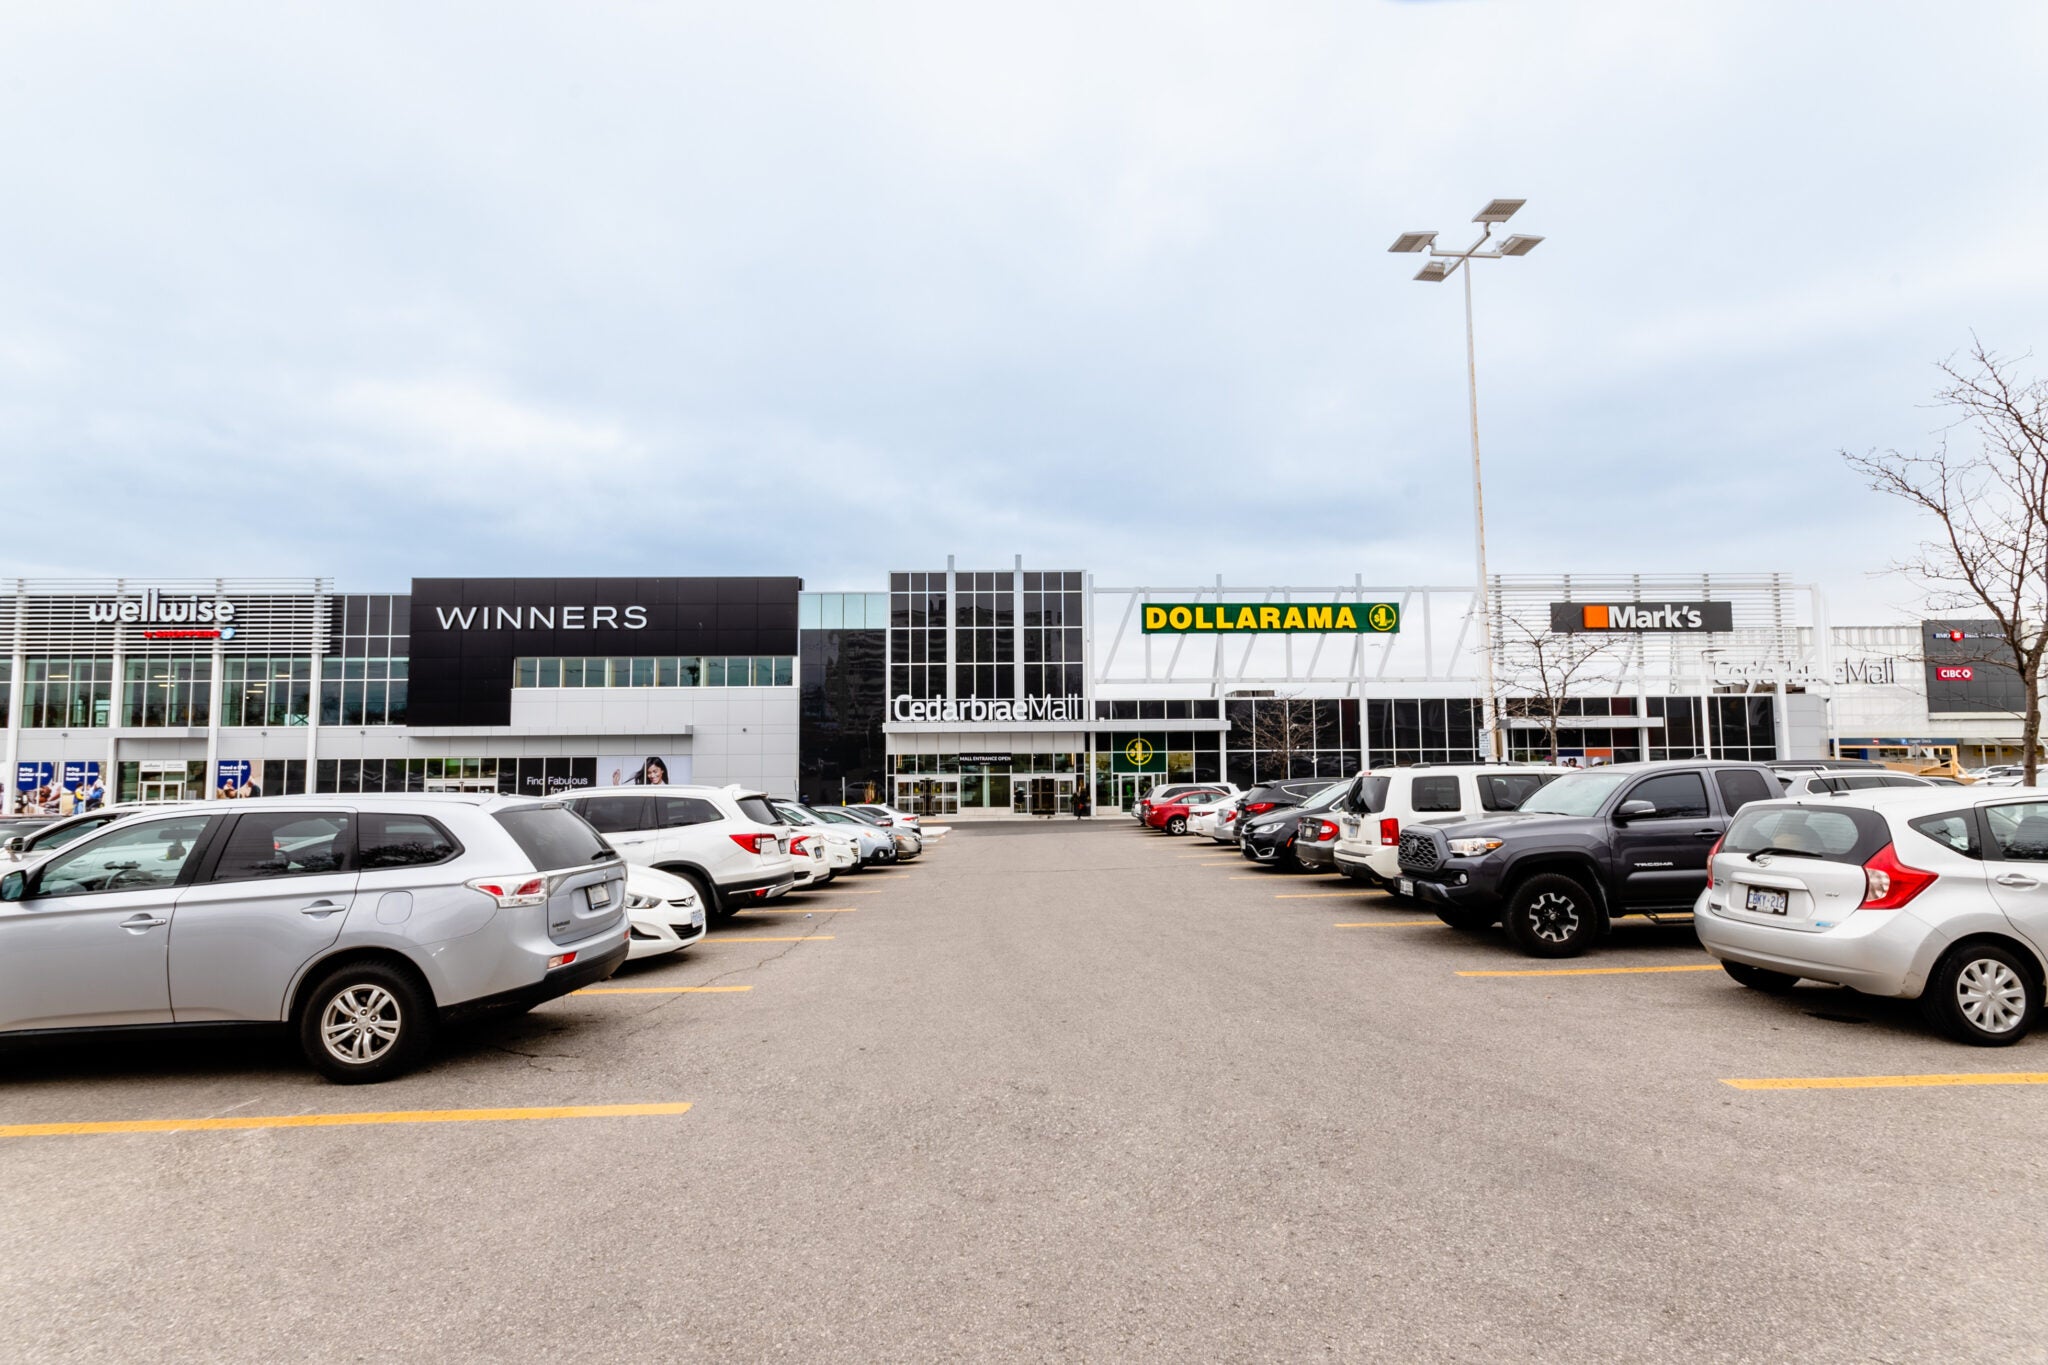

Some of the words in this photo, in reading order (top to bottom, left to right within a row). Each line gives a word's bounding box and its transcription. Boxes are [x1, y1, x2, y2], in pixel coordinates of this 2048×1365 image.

[89, 588, 235, 623] wellwise
[436, 605, 648, 630] WINNERS
[1145, 606, 1358, 630] DOLLARAMA
[1608, 604, 1703, 629] Mark's
[1940, 669, 1963, 678] CIBC
[893, 693, 1079, 721] CedarbraeMall
[547, 776, 588, 785] Fabulous
